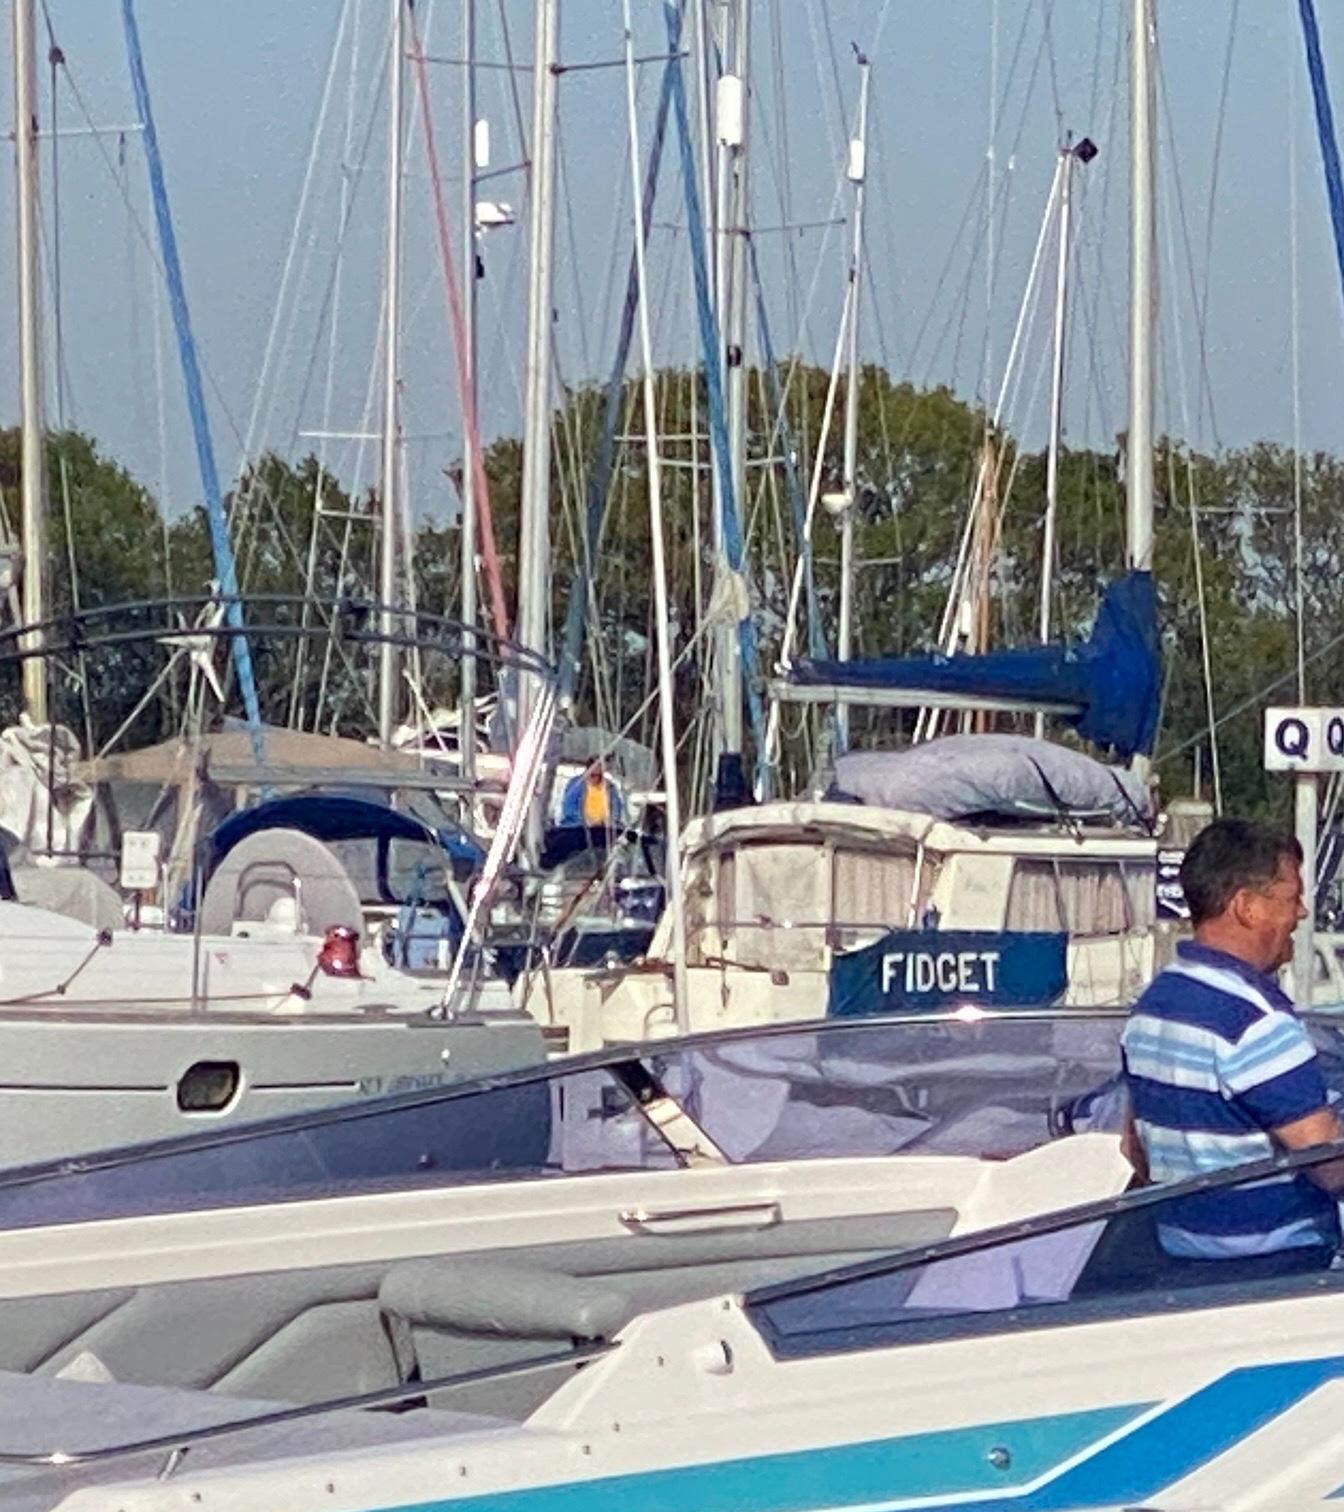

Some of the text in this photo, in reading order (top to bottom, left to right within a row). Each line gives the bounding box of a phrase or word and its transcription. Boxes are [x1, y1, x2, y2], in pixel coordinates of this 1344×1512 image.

[1275, 717, 1309, 760] Q
[1327, 716, 1344, 757] Q
[882, 951, 1001, 994] FIDGET
